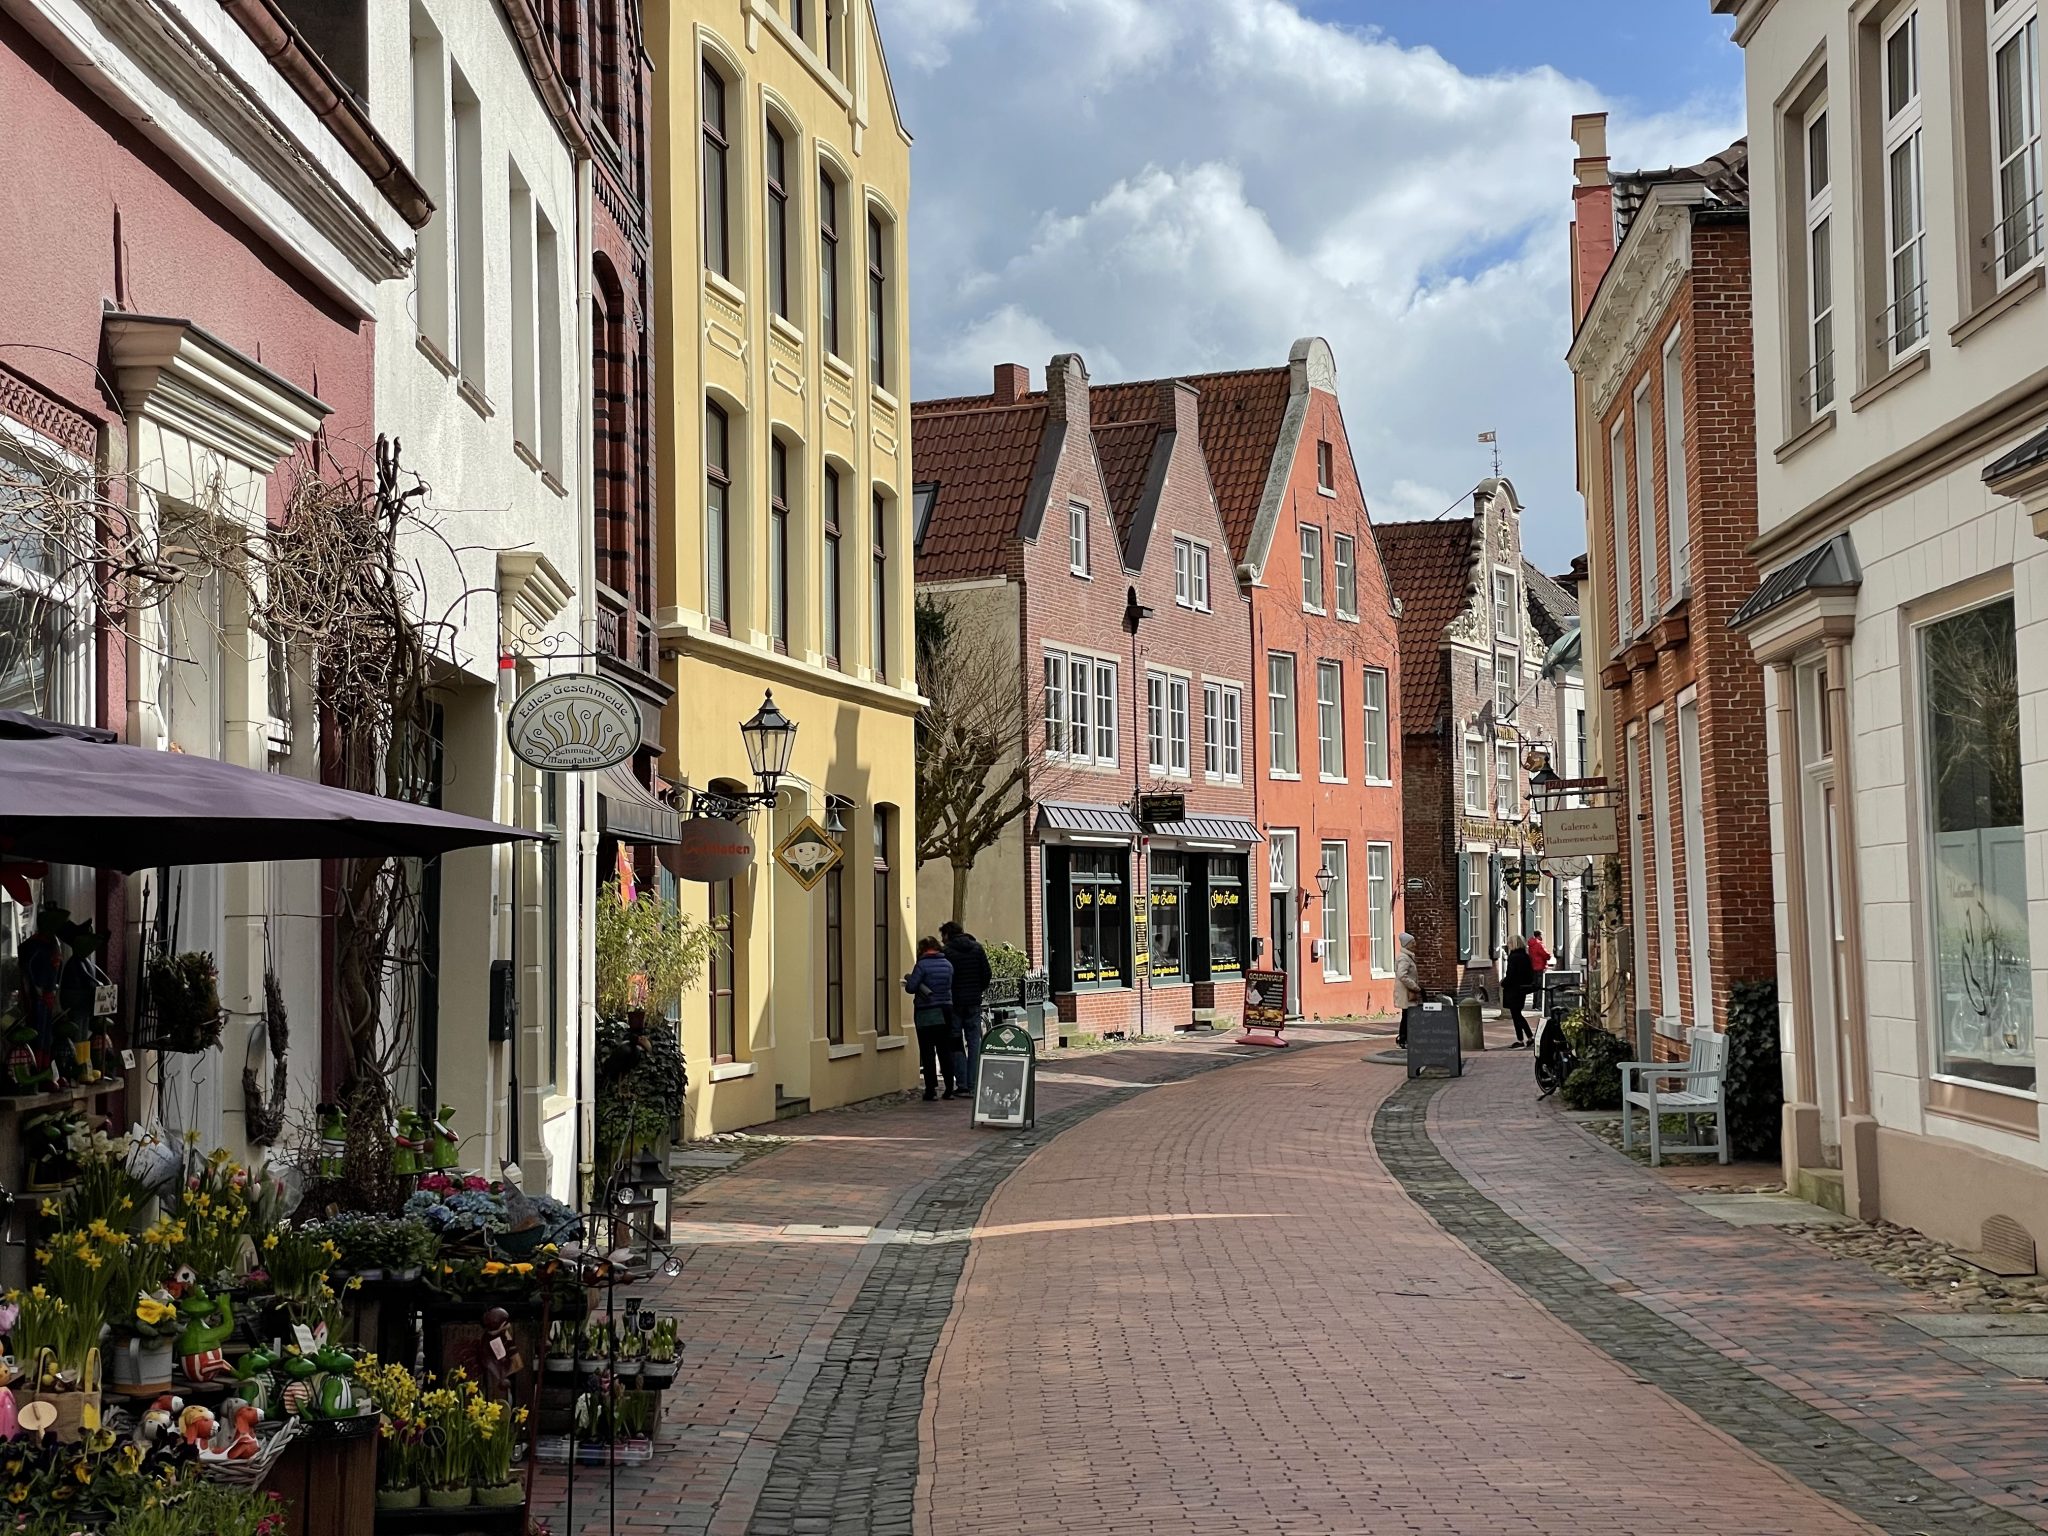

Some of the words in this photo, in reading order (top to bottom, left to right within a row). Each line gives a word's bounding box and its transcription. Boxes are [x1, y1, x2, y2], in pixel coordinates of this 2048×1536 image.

[519, 693, 552, 718] Edles
[553, 685, 628, 716] Geschmeide
[548, 756, 601, 765] Manufaktur
[1560, 822, 1591, 832] Galerie
[1592, 822, 1598, 830] &
[1546, 833, 1615, 845] Rahmenwerkstatt
[1098, 888, 1117, 906] Zeiten
[1151, 889, 1160, 905] ute
[1160, 889, 1177, 906] Zeiten
[1223, 889, 1239, 906] Zeiten
[1248, 972, 1284, 983] GOLDANKAUF
